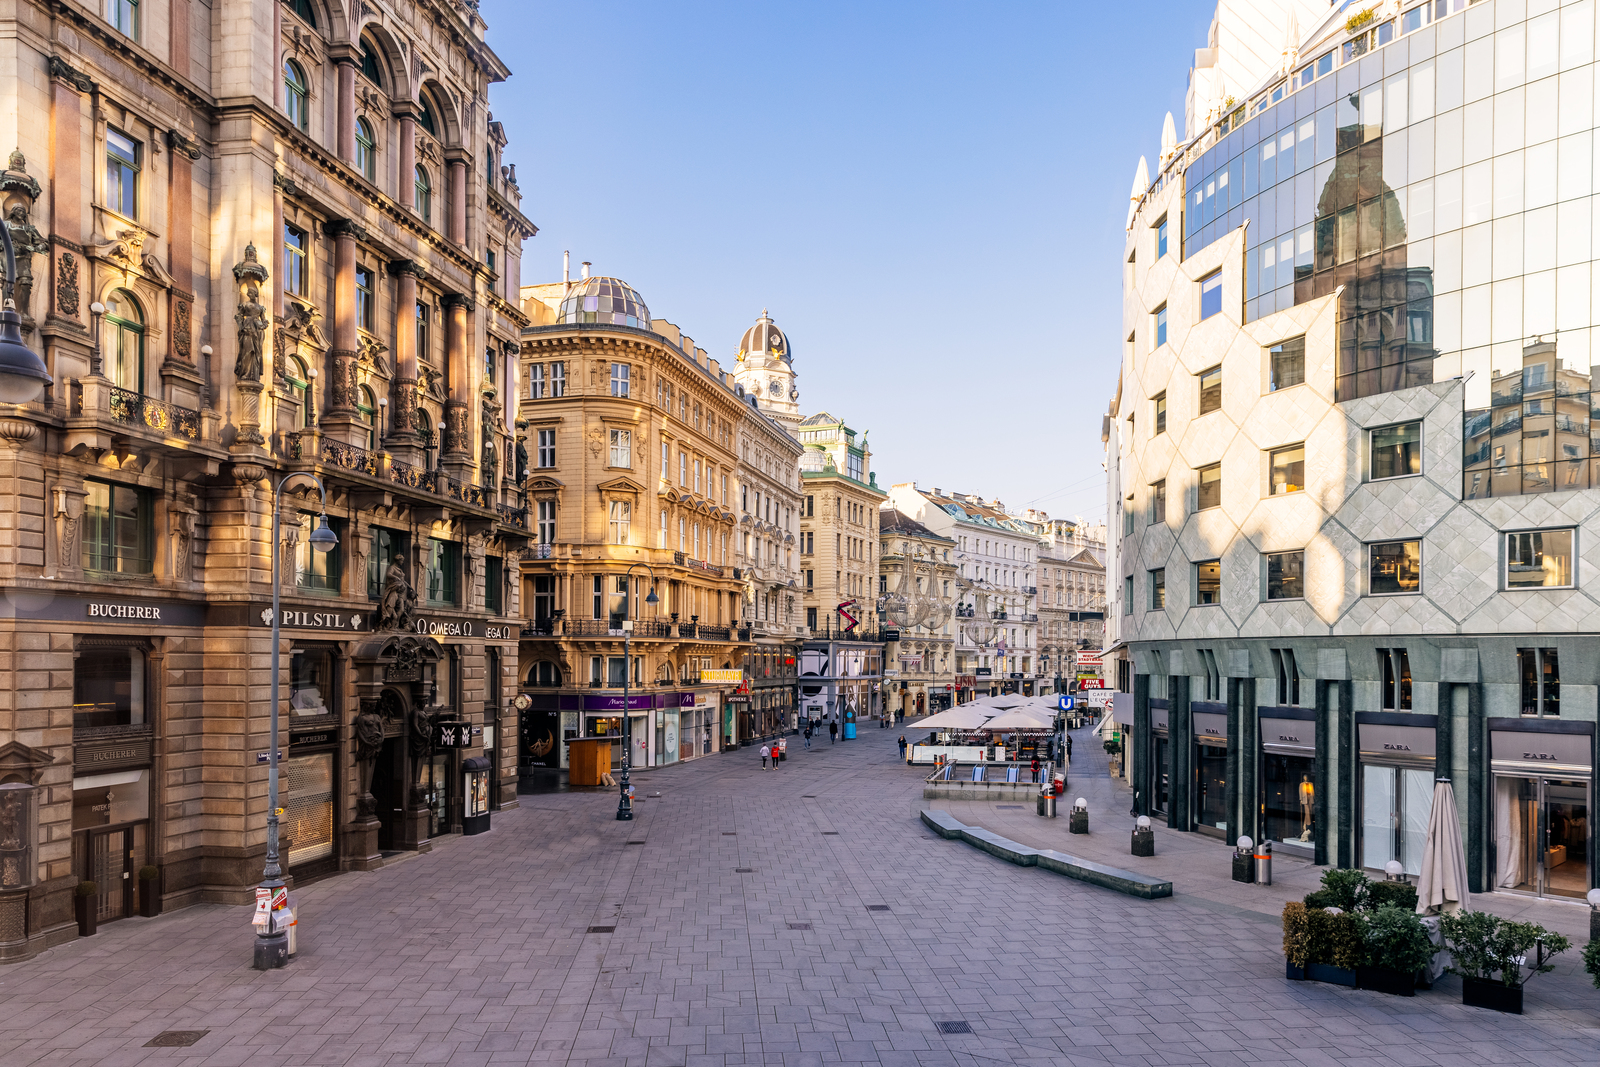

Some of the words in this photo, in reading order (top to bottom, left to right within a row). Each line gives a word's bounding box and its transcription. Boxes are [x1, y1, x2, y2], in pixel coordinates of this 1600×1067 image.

[89, 603, 161, 619] BUCHERER
[281, 610, 345, 628] PILSTL
[429, 621, 461, 636] OMEGA
[485, 627, 501, 639] EGA
[299, 735, 328, 744] BUCHERER
[1383, 743, 1411, 751] ZARA
[93, 750, 136, 761] BUCHERER
[1522, 752, 1558, 761] ZARA
[92, 804, 107, 812] PATEK
